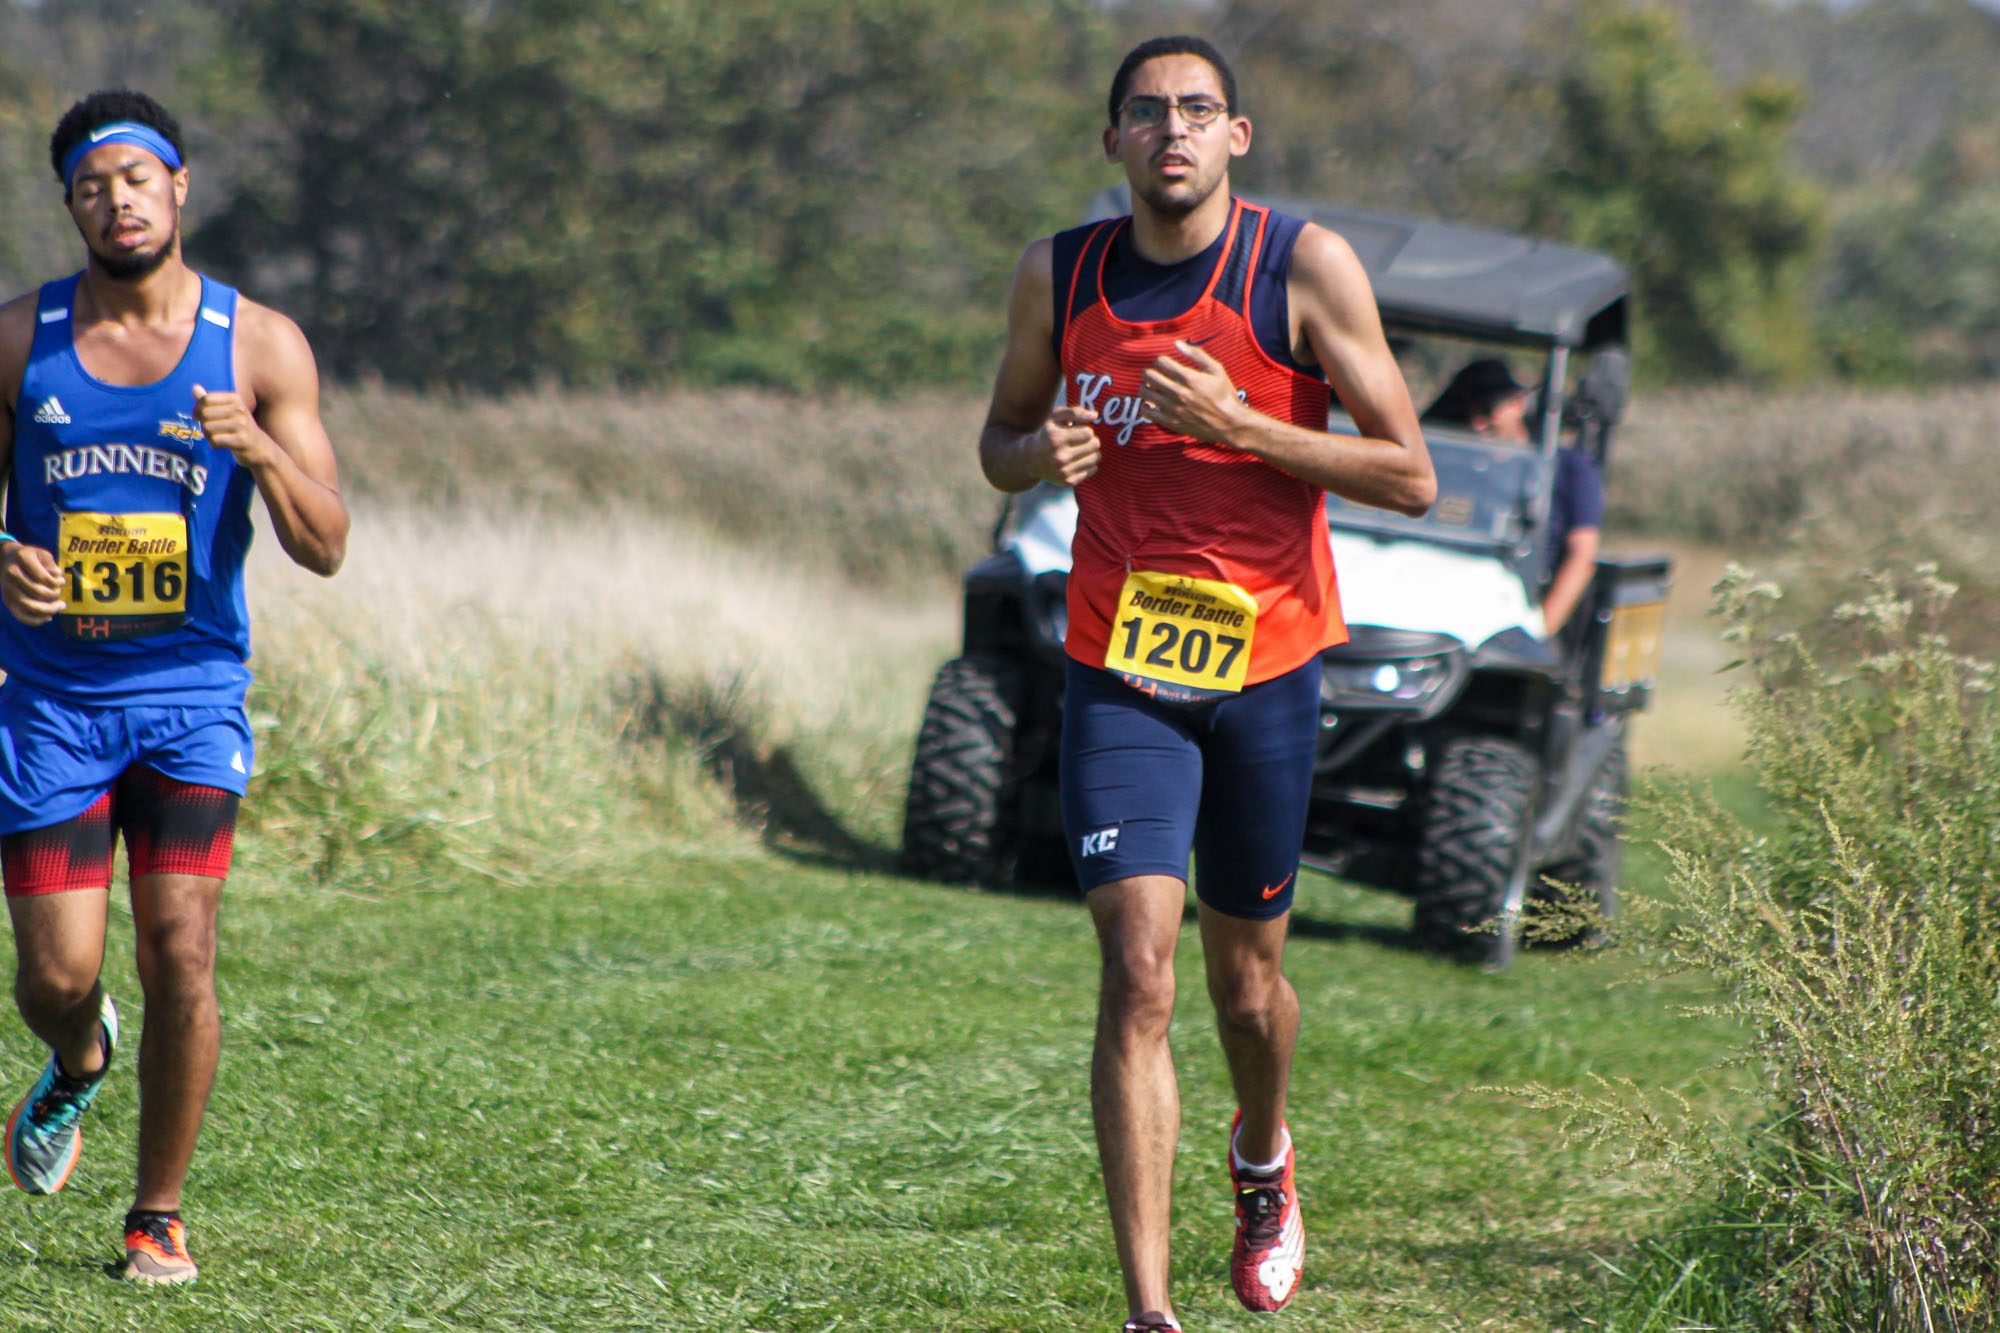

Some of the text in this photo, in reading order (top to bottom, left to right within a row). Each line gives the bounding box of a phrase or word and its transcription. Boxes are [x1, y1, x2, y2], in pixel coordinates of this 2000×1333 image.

[34, 414, 72, 424] adidas
[44, 444, 208, 496] RUNNERS
[67, 536, 177, 554] Border Battle
[64, 560, 183, 603] 1316
[1130, 590, 1192, 617] Border
[1192, 603, 1245, 628] Battle
[1121, 616, 1246, 680] 1207
[1082, 828, 1119, 857] KC
